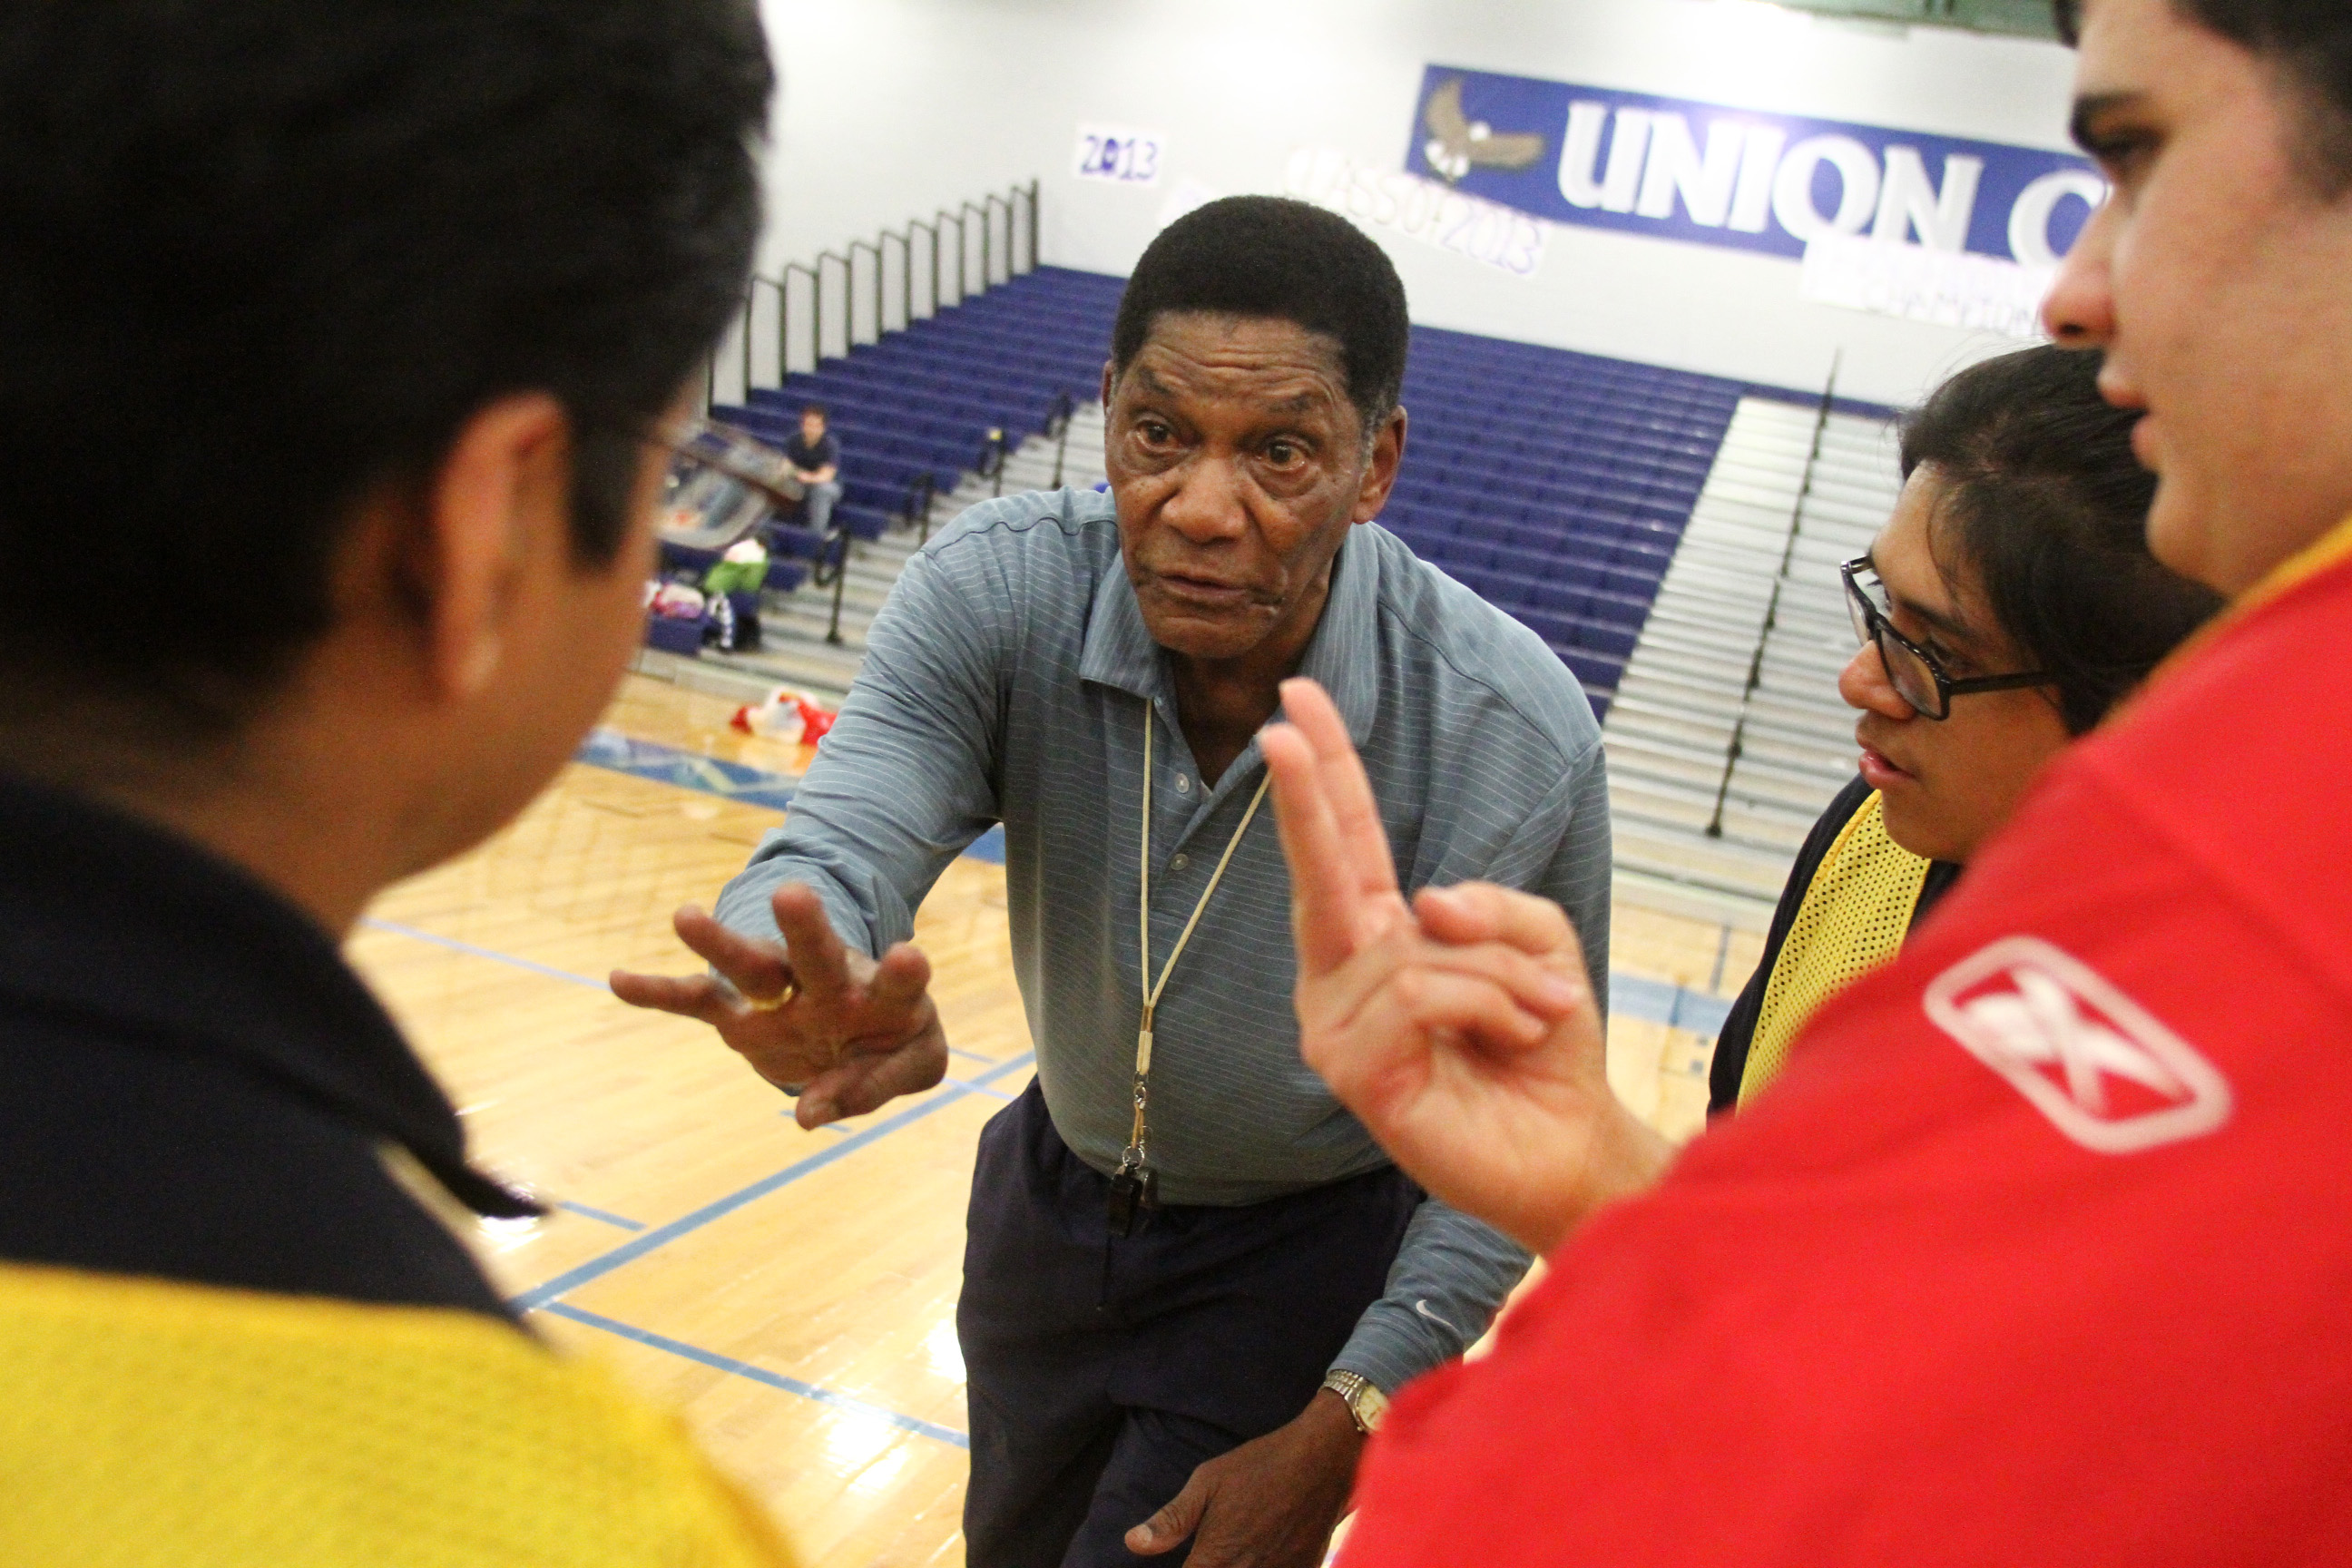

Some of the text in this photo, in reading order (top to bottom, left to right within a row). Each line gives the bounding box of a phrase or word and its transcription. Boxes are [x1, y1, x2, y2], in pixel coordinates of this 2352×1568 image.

[1080, 134, 1158, 181] 2013
[1557, 101, 1984, 253] UNION
[2007, 168, 2112, 270] C
[1439, 192, 1543, 275] 2013
